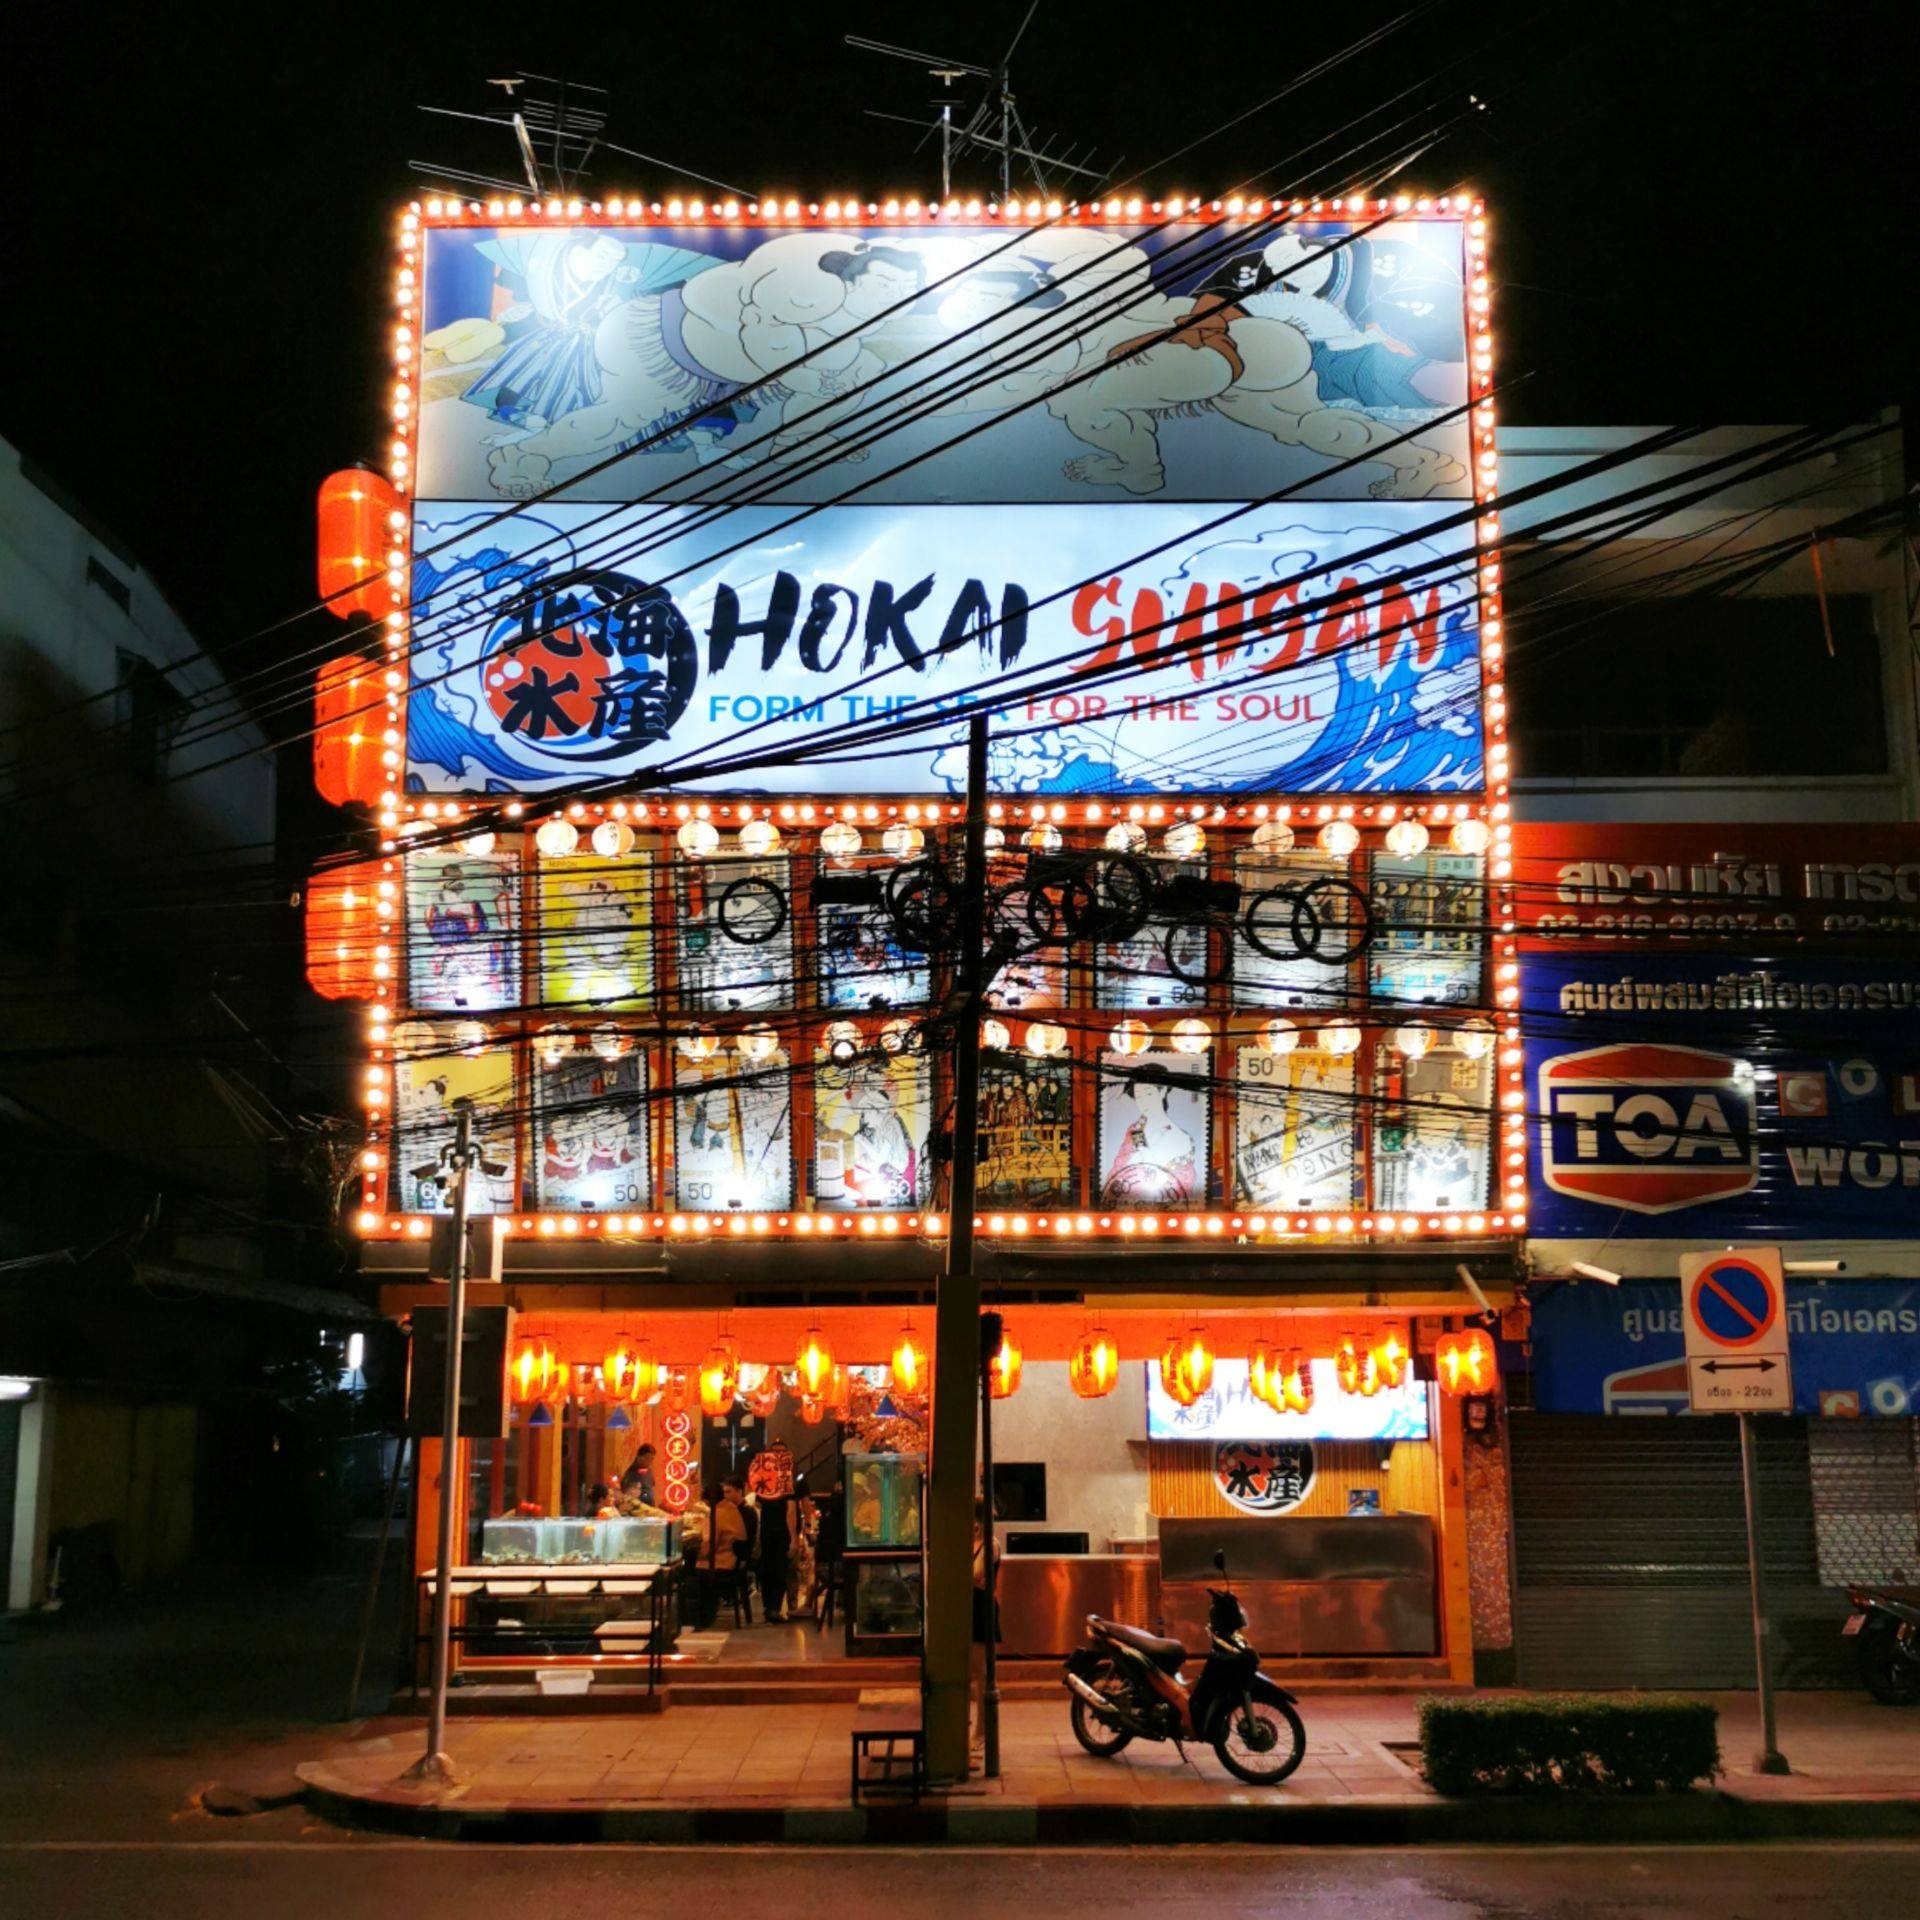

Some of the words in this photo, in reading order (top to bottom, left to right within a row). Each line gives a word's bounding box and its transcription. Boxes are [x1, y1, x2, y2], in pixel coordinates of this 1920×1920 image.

[706, 570, 1029, 678] HOKAI
[1067, 575, 1441, 681] SUISAN
[709, 694, 824, 724] FORM
[840, 694, 917, 724] THE
[1027, 694, 1108, 723] FOR
[1124, 694, 1198, 722] THE
[1215, 694, 1323, 722] SOUL
[1172, 986, 1196, 1003] 50
[1248, 1057, 1273, 1076] 50
[1556, 1094, 1743, 1158] TOA
[615, 1184, 639, 1202] 50
[687, 1182, 713, 1201] 50
